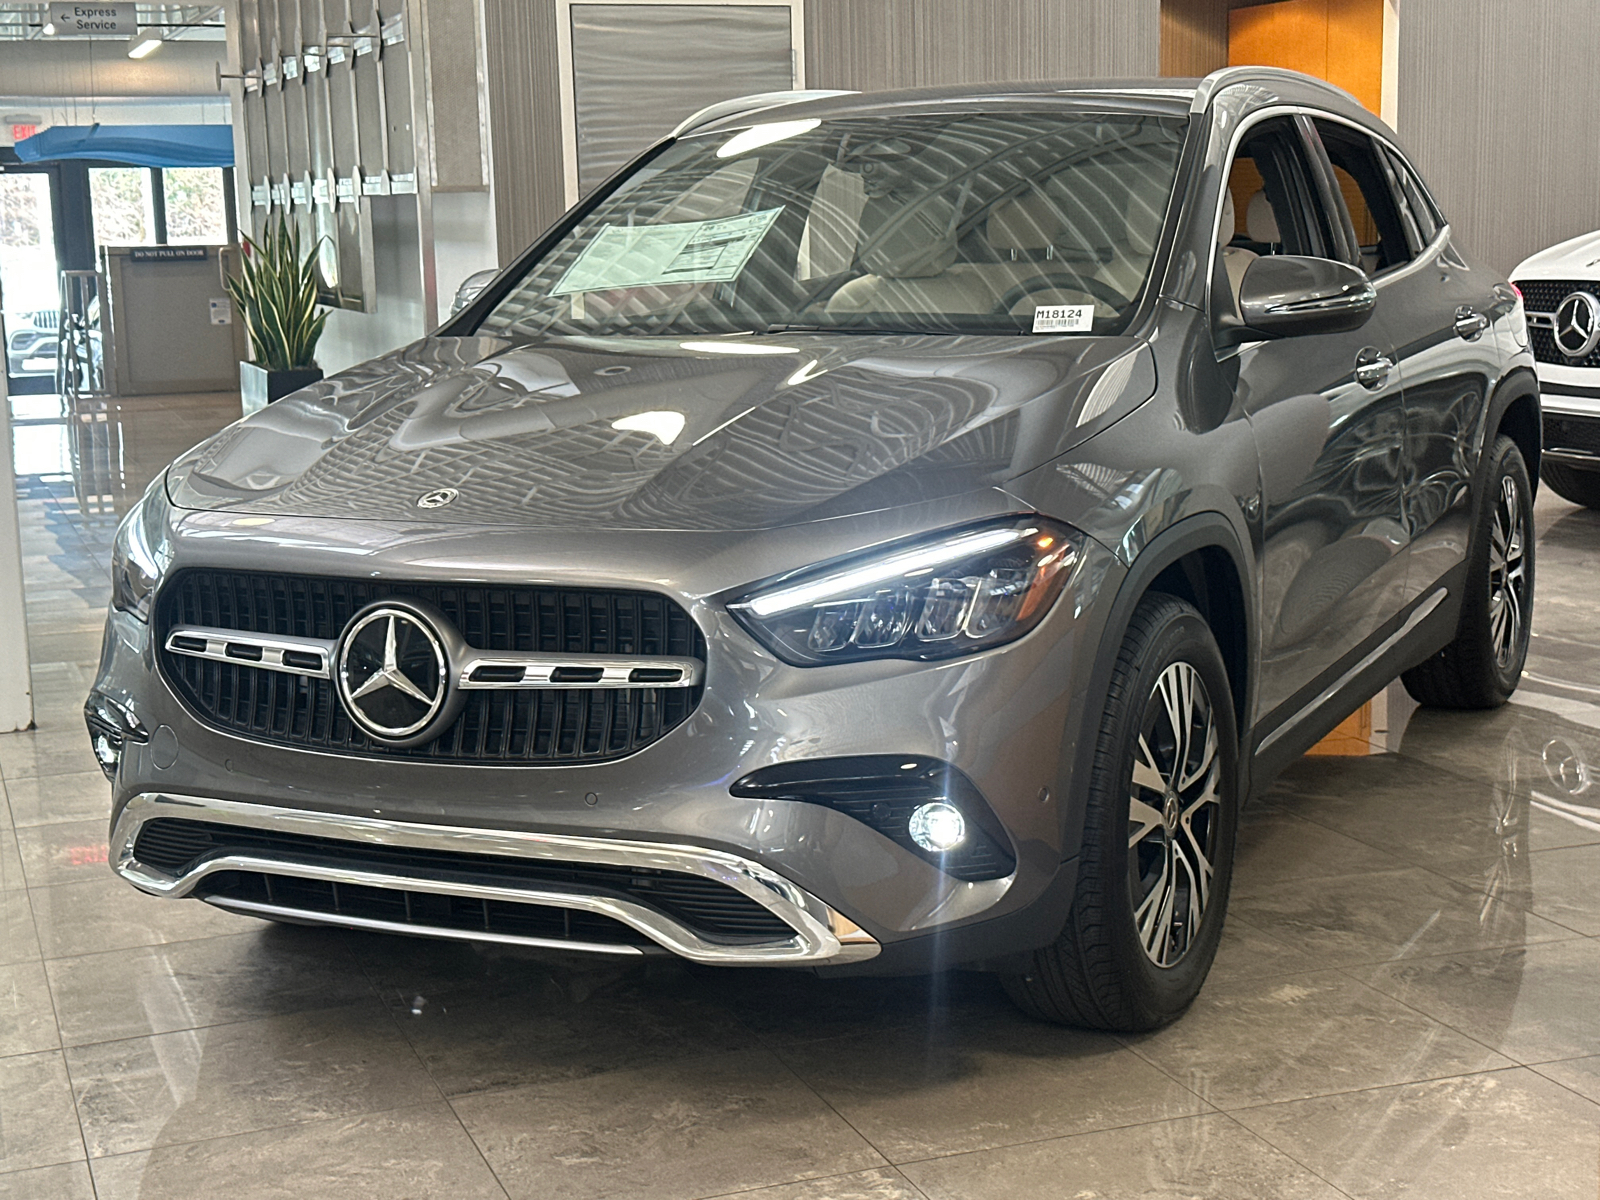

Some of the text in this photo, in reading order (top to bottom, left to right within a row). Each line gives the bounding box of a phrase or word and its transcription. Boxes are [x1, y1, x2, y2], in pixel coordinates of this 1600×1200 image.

[74, 7, 117, 18] Express
[76, 20, 117, 30] Service
[13, 124, 36, 139] EXIT
[1036, 309, 1082, 319] M18124
